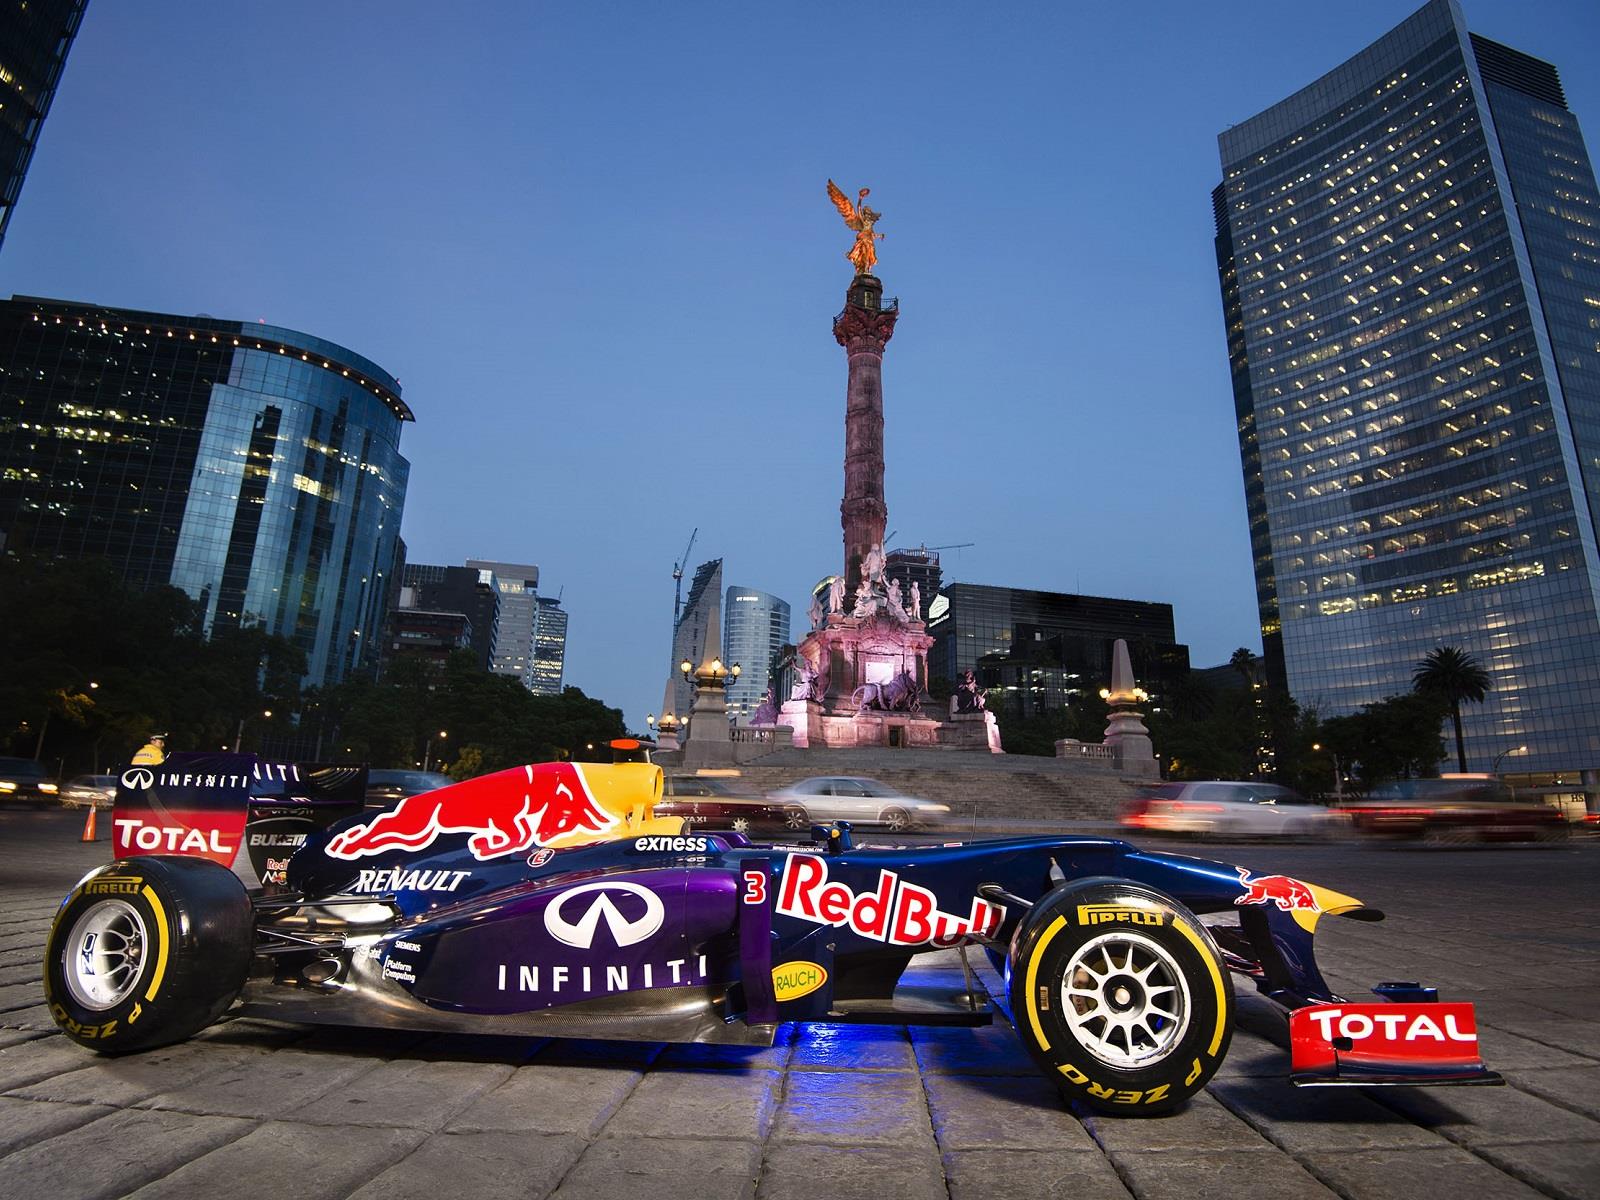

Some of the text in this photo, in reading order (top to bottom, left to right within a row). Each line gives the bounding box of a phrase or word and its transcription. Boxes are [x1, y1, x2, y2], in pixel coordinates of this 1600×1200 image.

[160, 773, 248, 788] INFINITI
[683, 815, 707, 823] TAXI
[634, 836, 708, 853] exness
[85, 876, 144, 895] PIRELLI
[355, 869, 473, 893] RENAULT
[743, 870, 767, 905] 3
[1076, 903, 1165, 927] PIRELLI
[394, 940, 422, 952] SIEMENS
[387, 959, 413, 972] Platform
[498, 954, 708, 993] INFINITI
[385, 968, 416, 984] Computing
[775, 970, 817, 991] RAUCH
[51, 1001, 143, 1039] P ZERO
[1056, 1057, 1204, 1105] P ZERO
